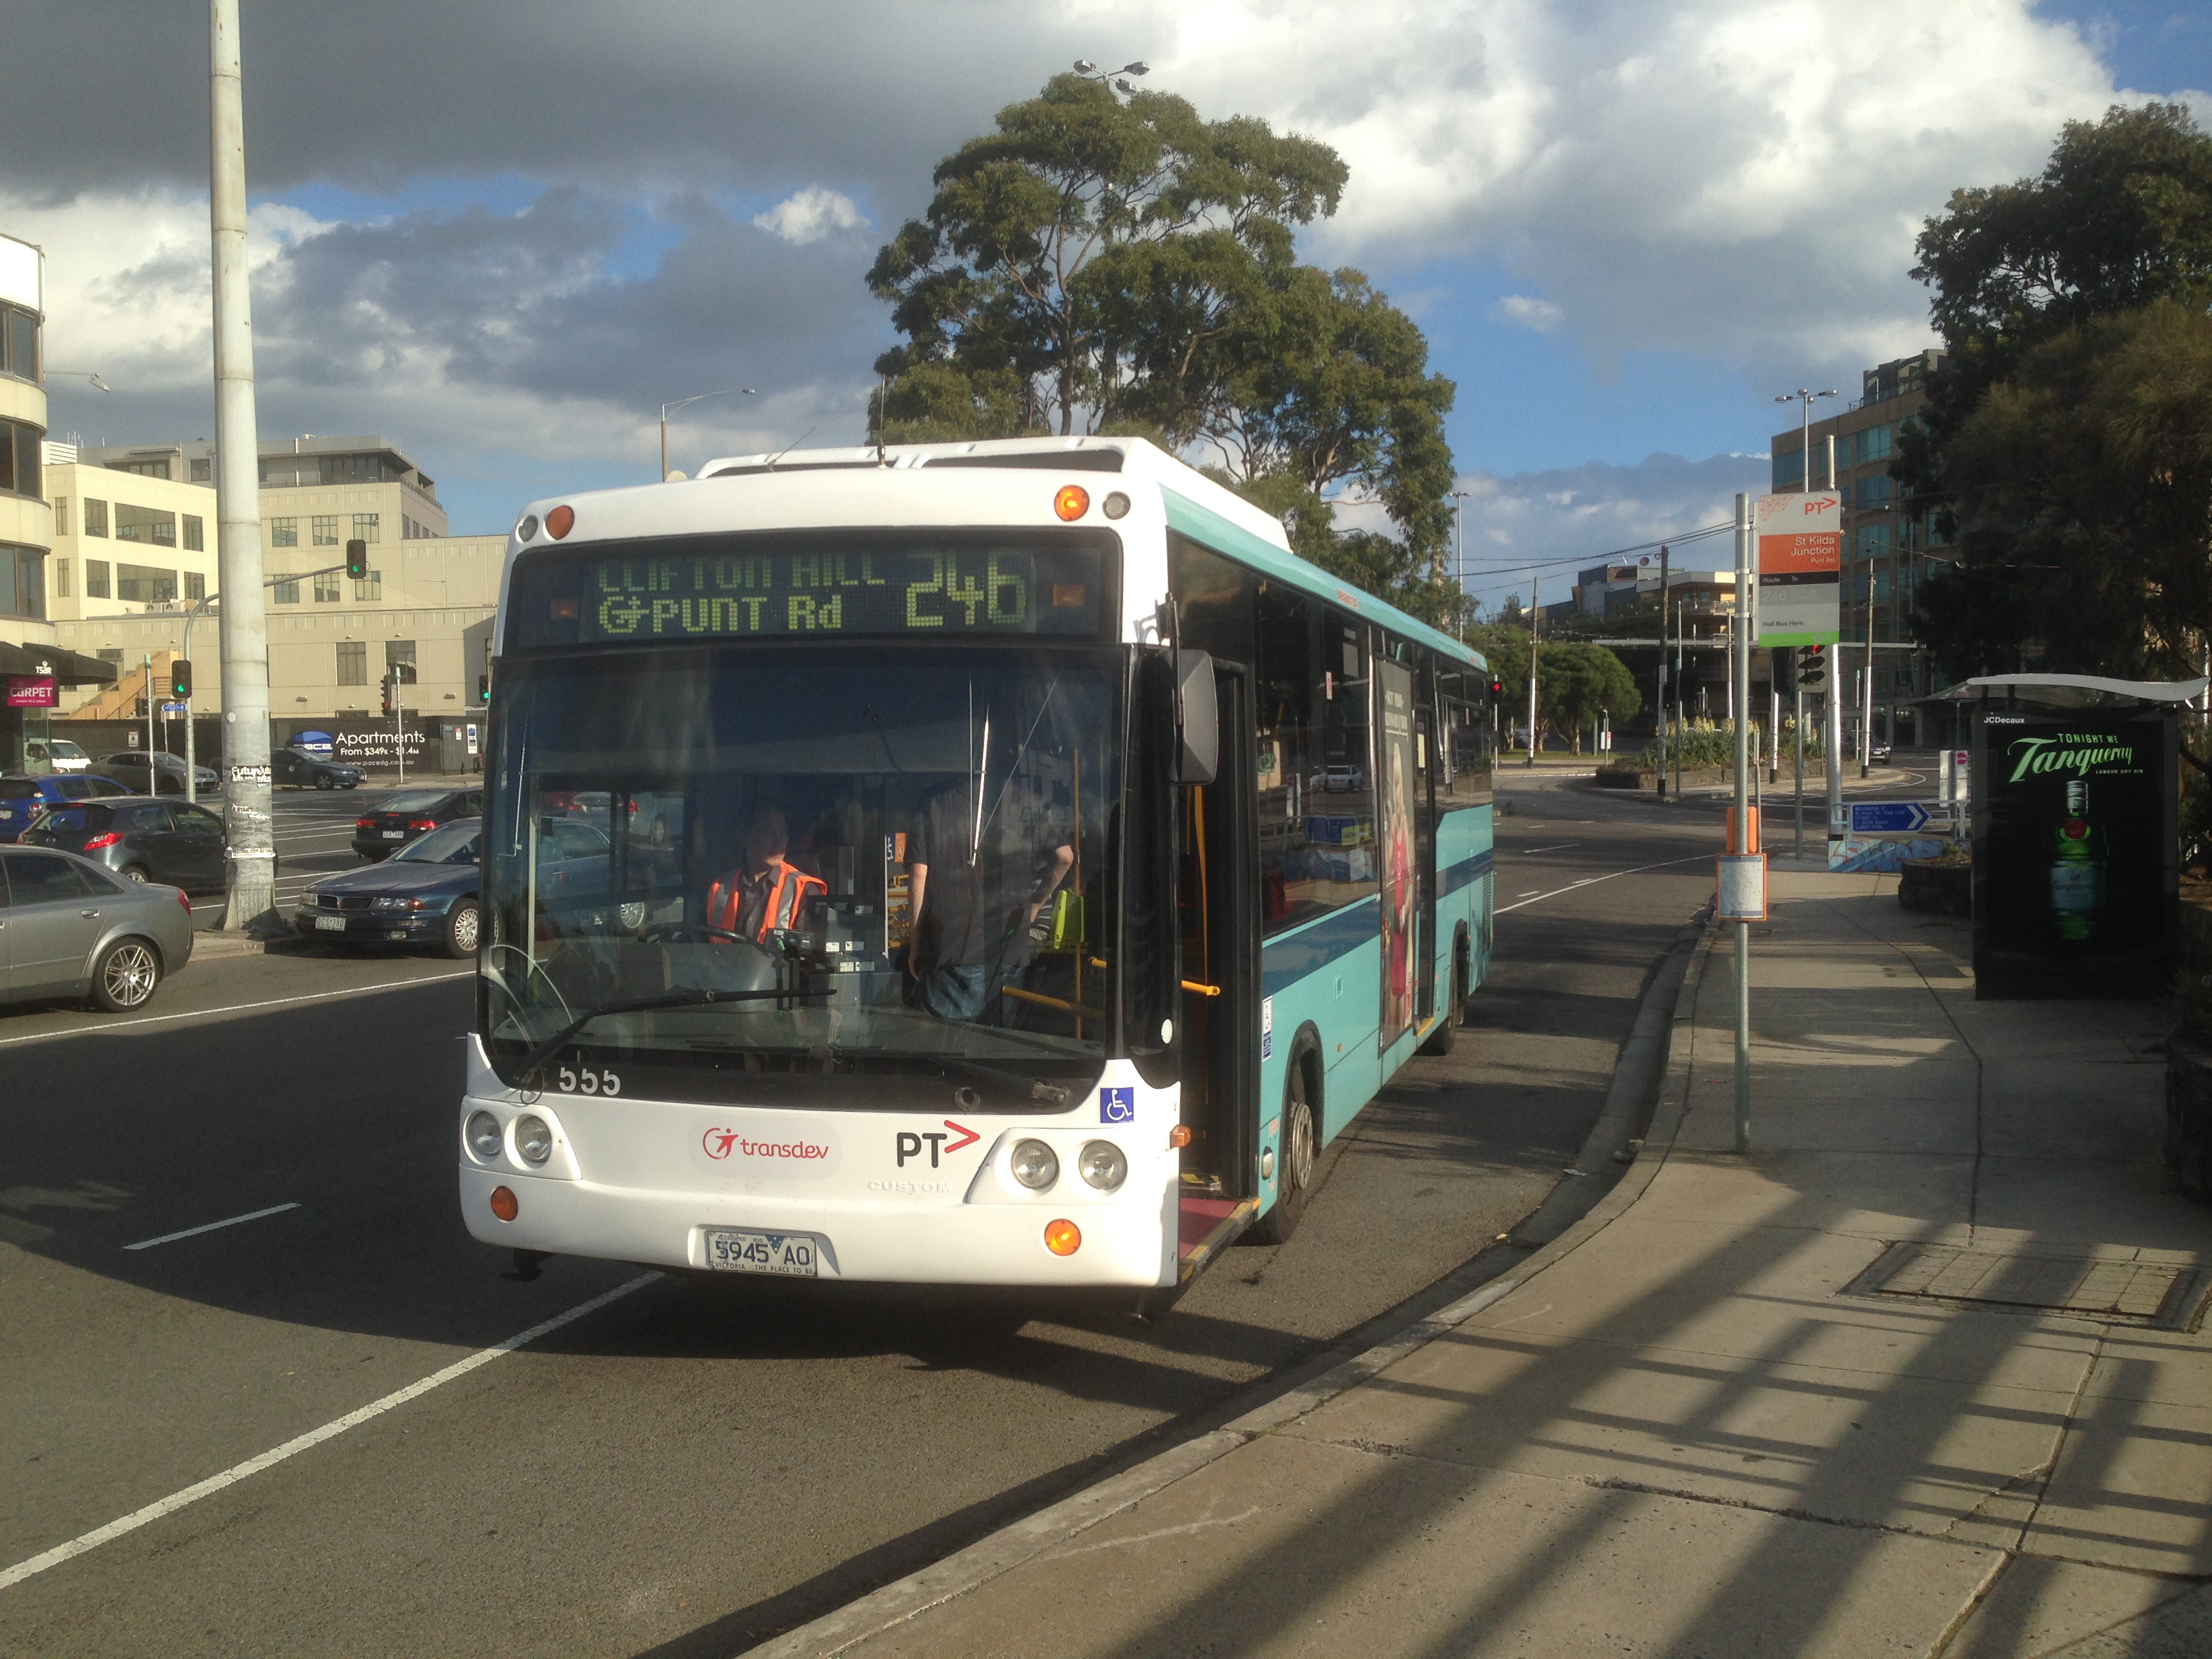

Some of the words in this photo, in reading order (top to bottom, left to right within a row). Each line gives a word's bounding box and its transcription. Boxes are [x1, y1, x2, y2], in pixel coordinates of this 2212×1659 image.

[1791, 546, 1835, 556] Junction
[1795, 537, 1805, 545] St
[1809, 536, 1835, 545] Kilda
[792, 551, 886, 588] HILL
[906, 550, 1026, 627] 246
[1763, 590, 1786, 602] 246
[788, 594, 842, 630] Rd
[335, 731, 425, 746] Apartments
[2057, 733, 2104, 743] TONIGHT
[2106, 735, 2118, 743] WE
[2007, 737, 2132, 783] Tanqueray
[559, 1067, 621, 1096] 555
[740, 1139, 829, 1160] transdev
[867, 1181, 953, 1194] CUSTOM
[715, 1240, 769, 1263] 5945
